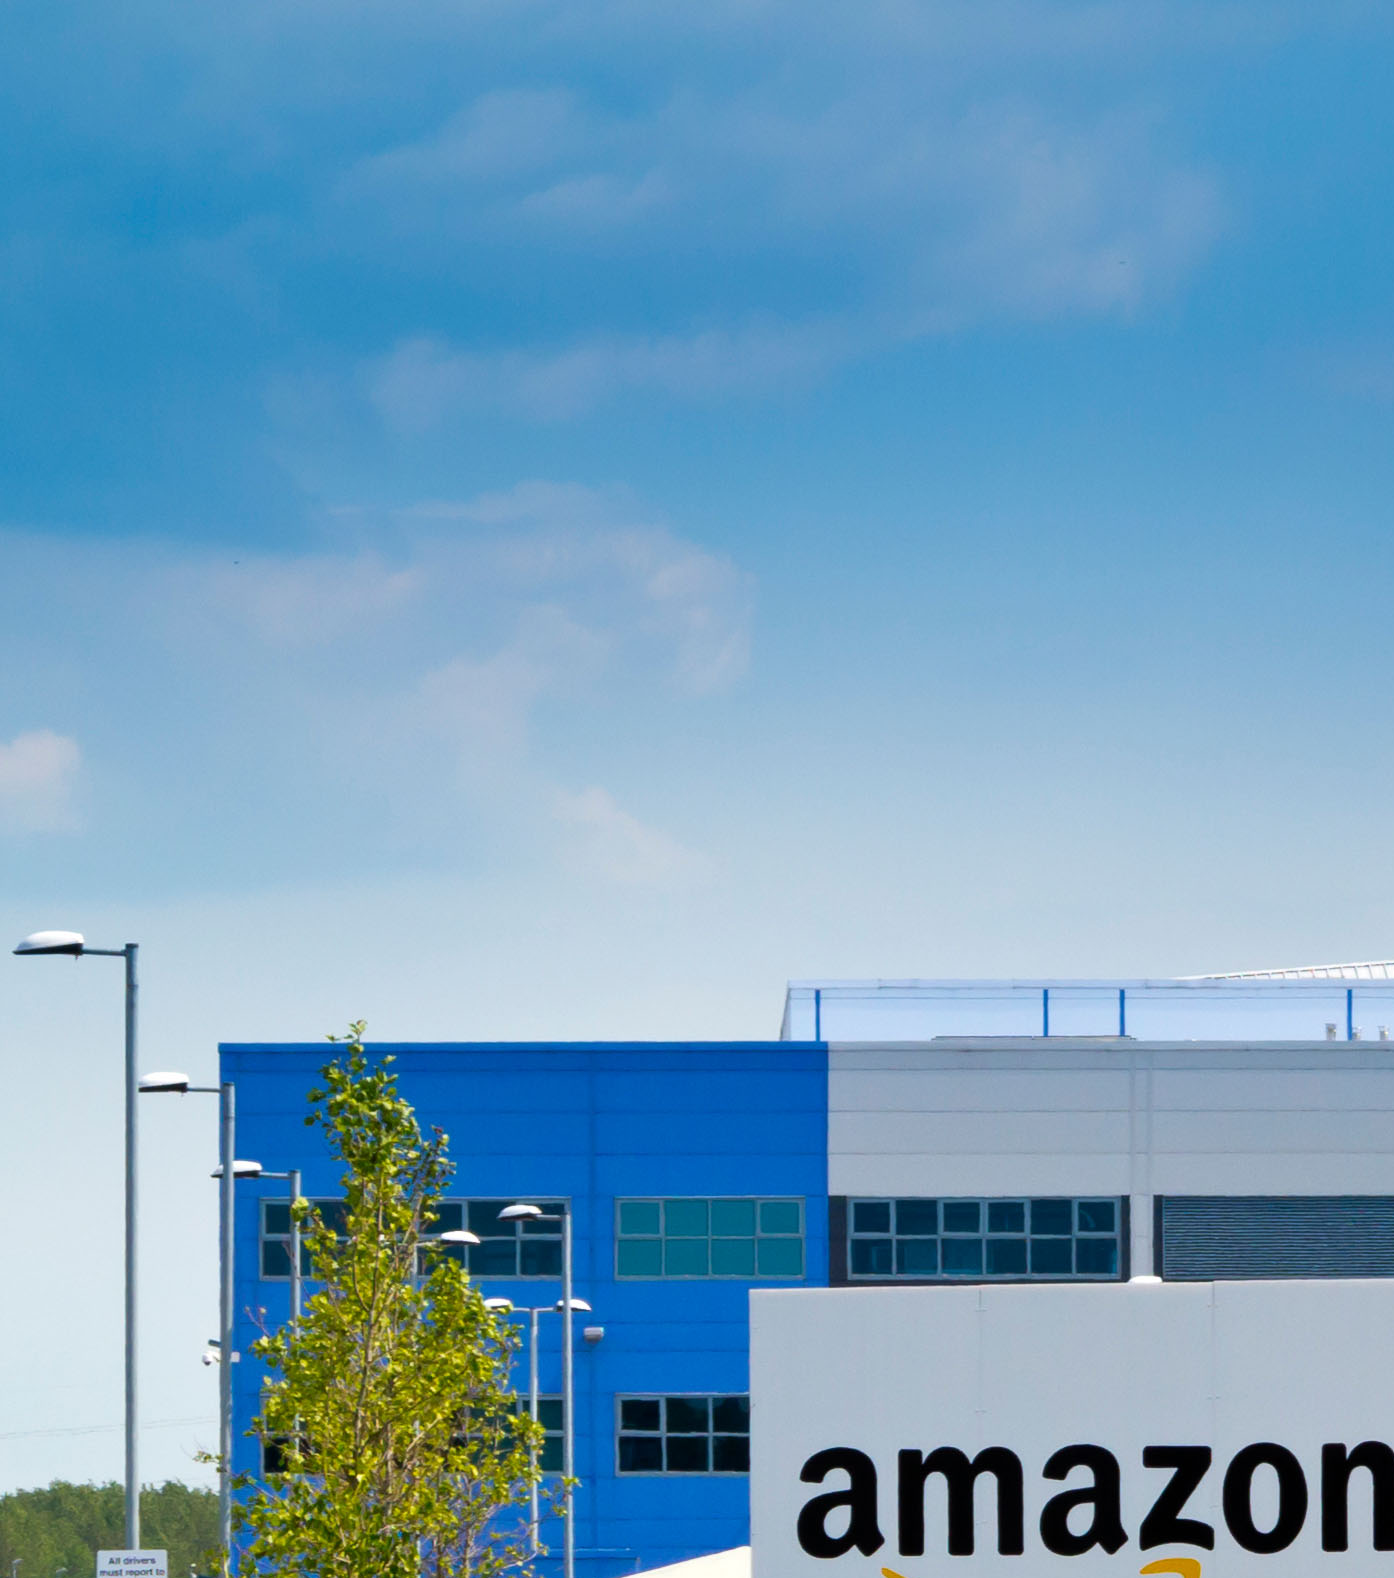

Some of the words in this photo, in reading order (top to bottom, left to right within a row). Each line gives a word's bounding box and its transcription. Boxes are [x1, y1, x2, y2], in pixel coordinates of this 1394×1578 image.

[109, 1557, 121, 1565] All
[123, 1557, 156, 1565] drivers
[100, 1569, 123, 1577] must
[126, 1568, 153, 1578] report
[156, 1568, 165, 1576] to
